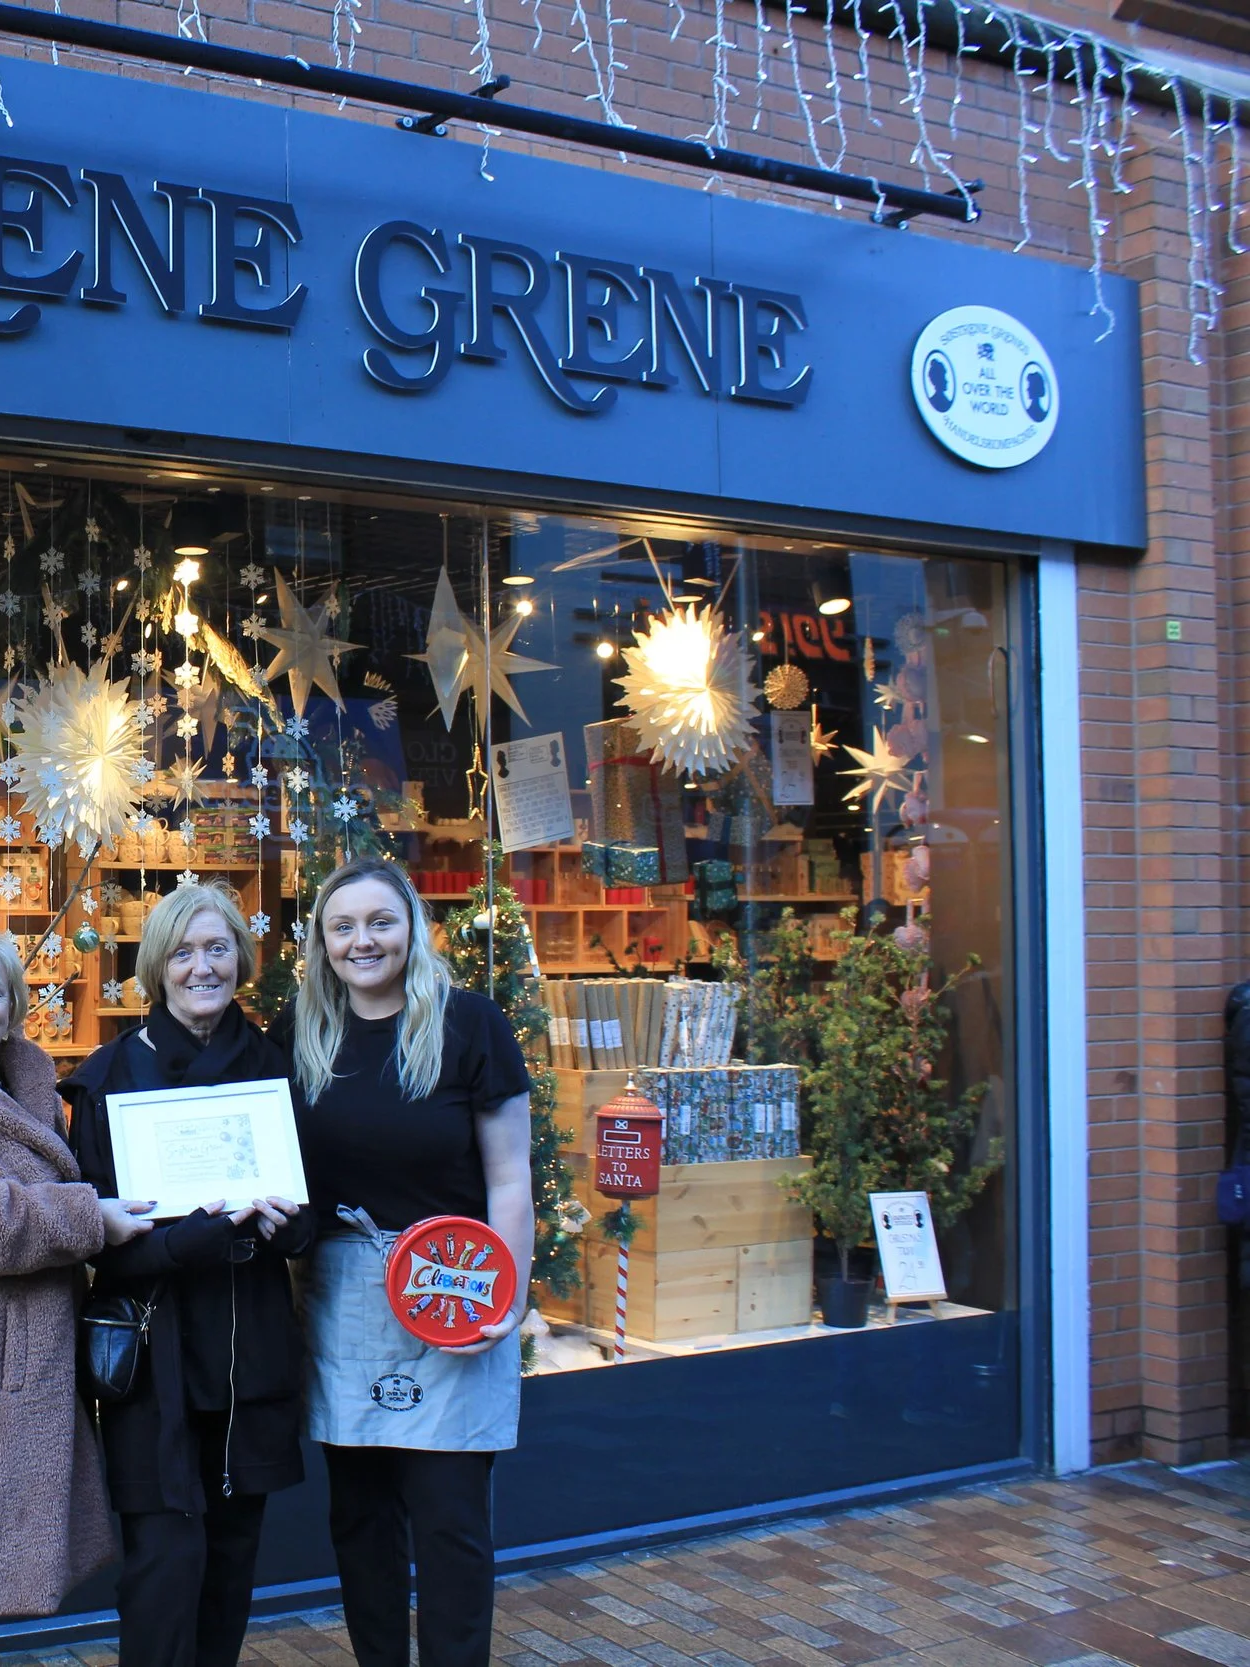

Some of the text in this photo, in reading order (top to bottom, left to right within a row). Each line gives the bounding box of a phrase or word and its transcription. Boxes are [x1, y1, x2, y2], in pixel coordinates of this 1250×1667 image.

[355, 220, 814, 412] GRENE
[978, 368, 996, 380] ALL
[962, 382, 1014, 400] OVER THE
[970, 401, 1010, 416] WORLD
[597, 1144, 649, 1159] LETTERS
[611, 1162, 628, 1172] TO
[598, 1172, 643, 1188] SANTA
